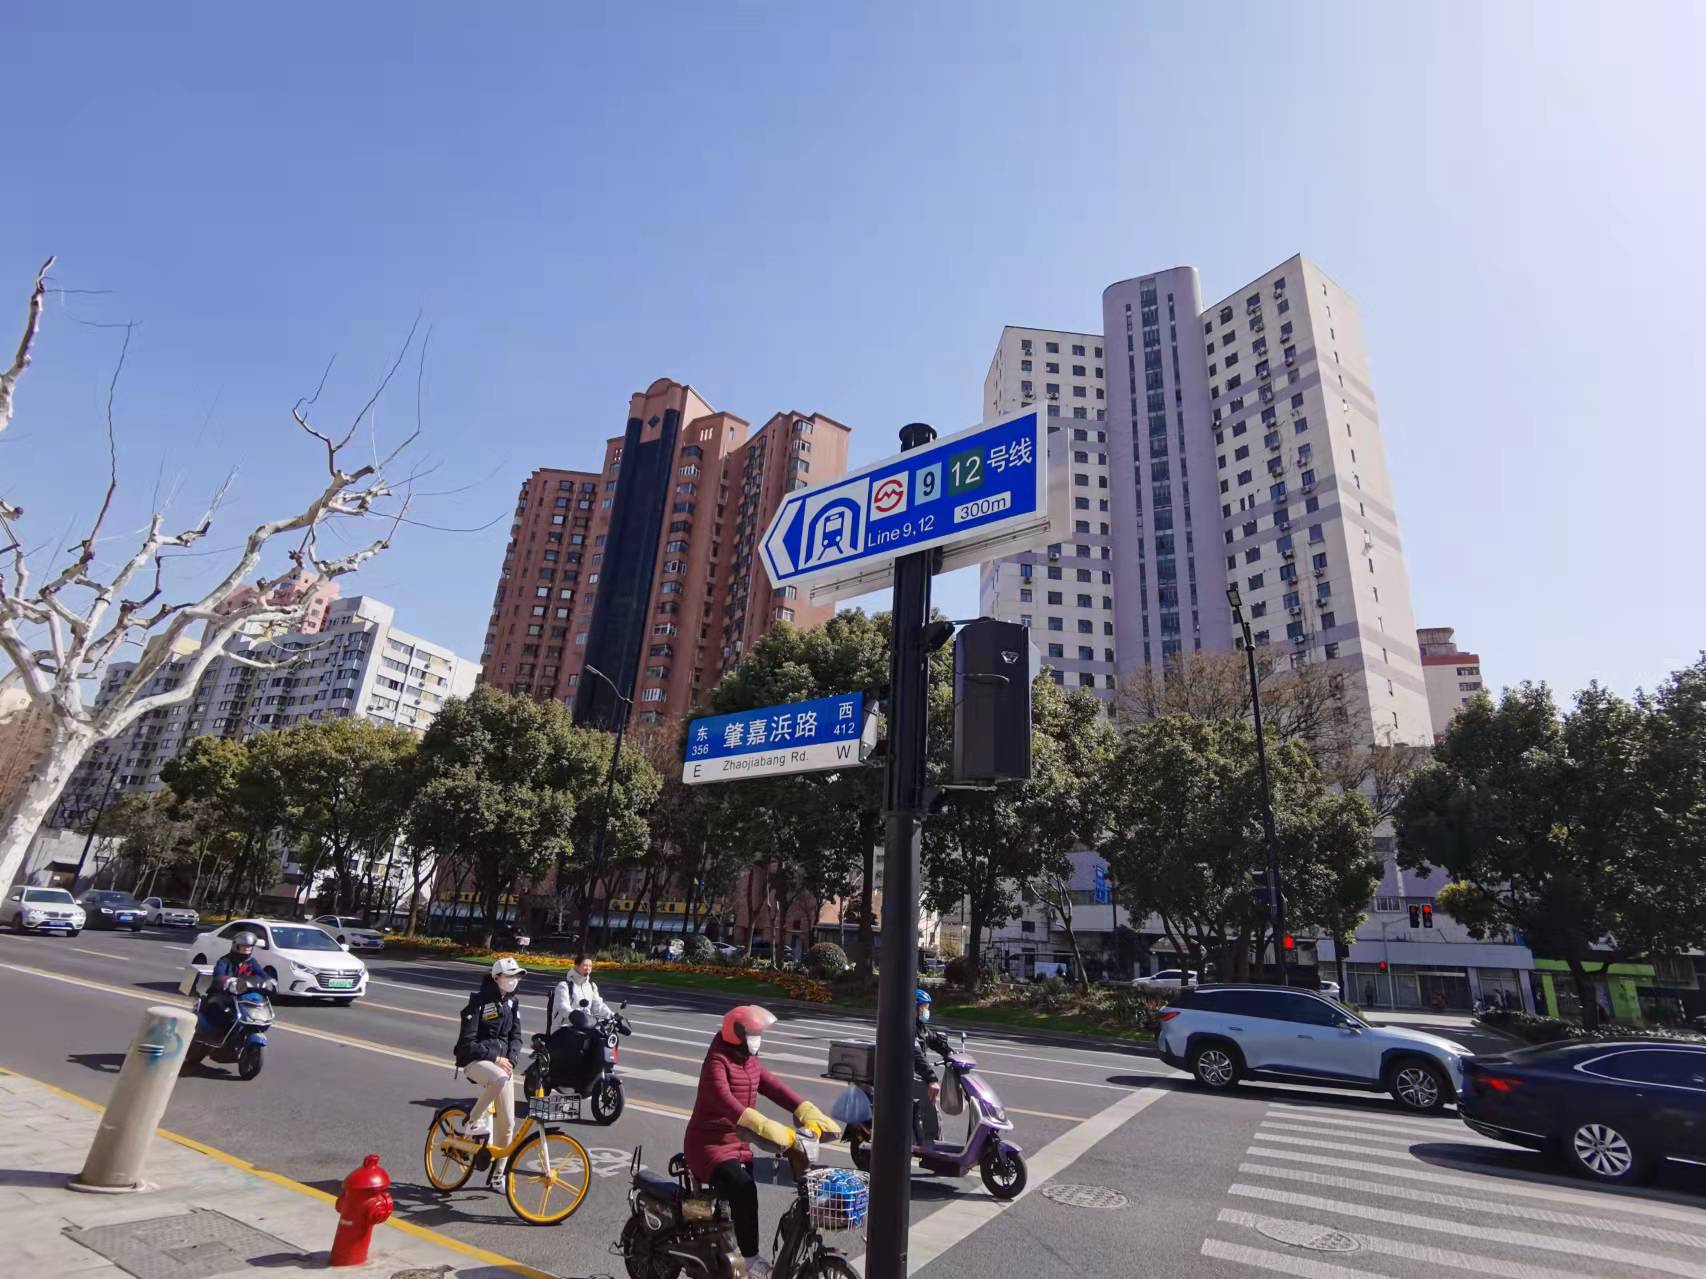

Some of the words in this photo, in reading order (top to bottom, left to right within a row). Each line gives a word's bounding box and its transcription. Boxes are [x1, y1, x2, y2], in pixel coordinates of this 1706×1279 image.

[923, 471, 935, 496] 9
[951, 455, 981, 487] 12
[986, 437, 1032, 473] 号线
[960, 497, 1006, 520] 300m
[868, 527, 899, 547] Line
[691, 743, 709, 756] 356
[833, 722, 855, 735] 412
[696, 725, 709, 742] 东
[723, 710, 818, 749] 肇嘉浜路
[839, 701, 854, 720] 西
[693, 764, 702, 778] E
[722, 754, 785, 771] Zhaojiabang
[791, 751, 809, 762] Rd.
[836, 744, 851, 760] W
